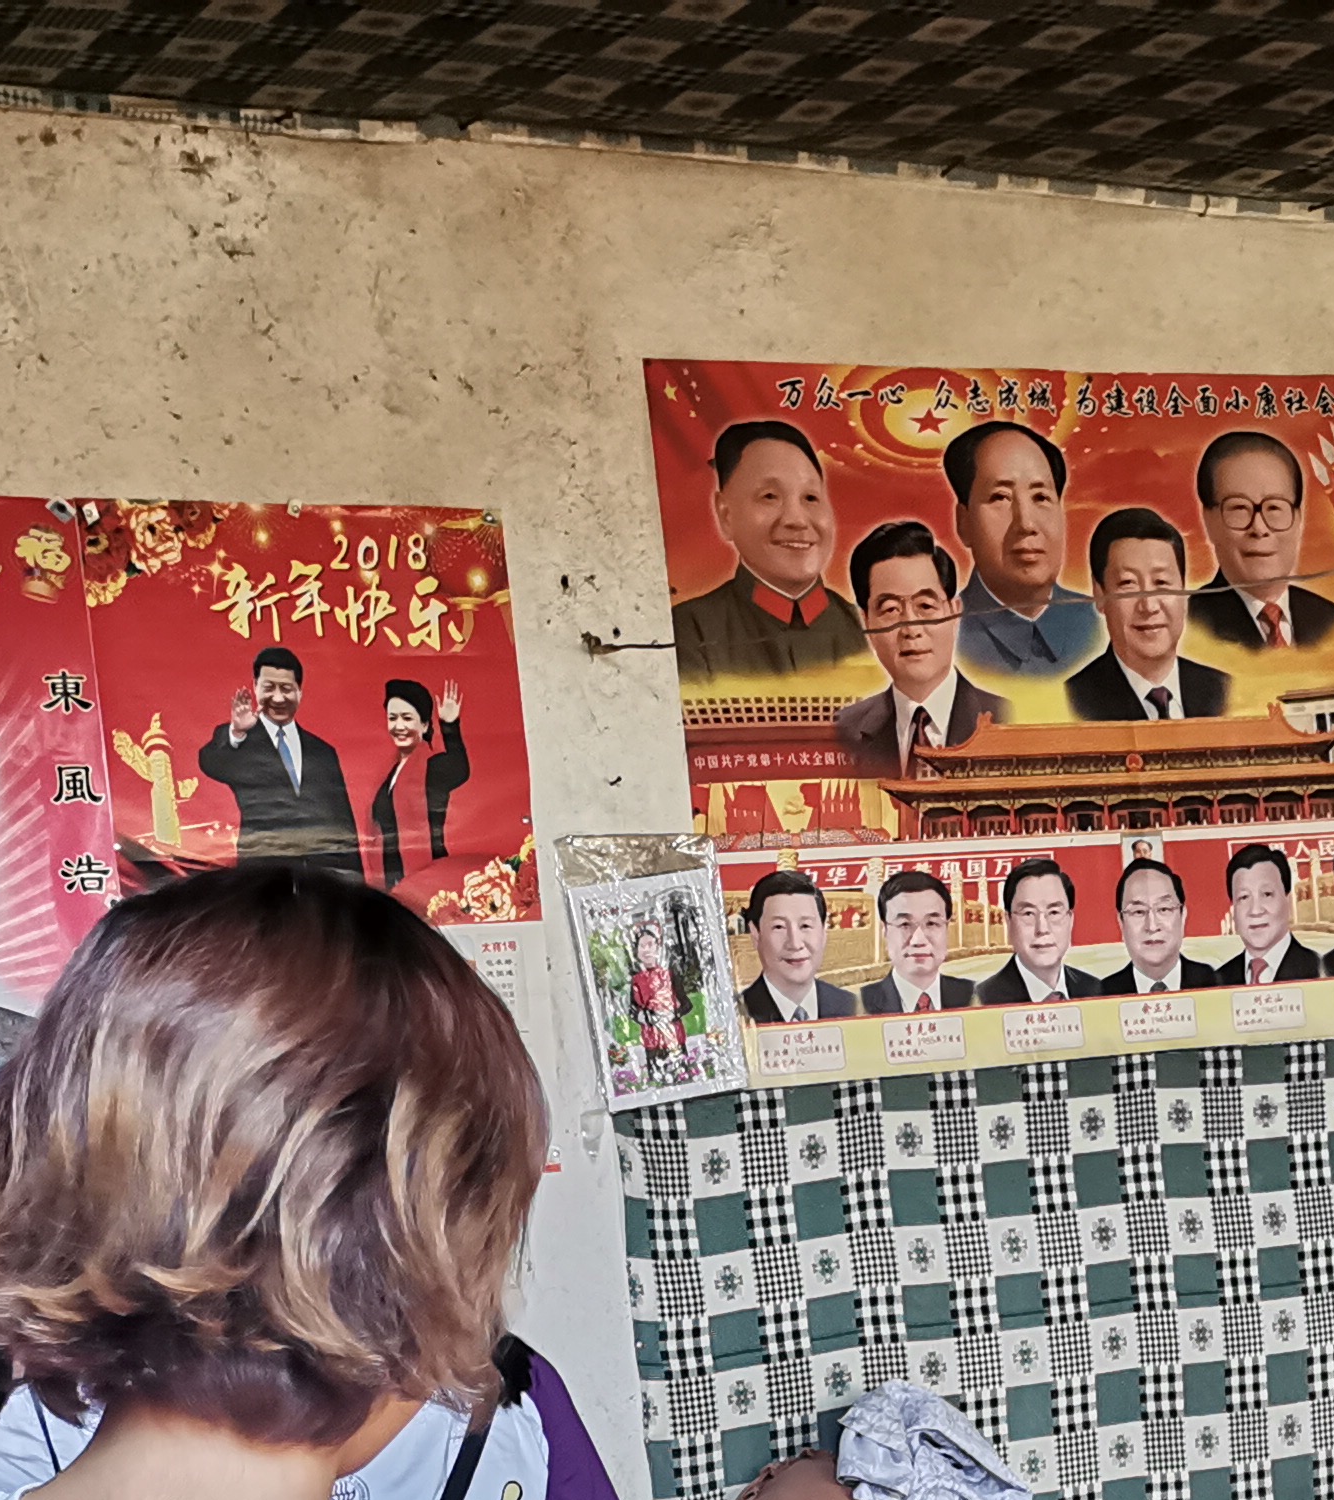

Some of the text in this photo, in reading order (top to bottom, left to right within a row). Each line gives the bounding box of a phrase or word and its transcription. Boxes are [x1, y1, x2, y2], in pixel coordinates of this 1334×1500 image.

[776, 376, 906, 411] 万众一心
[932, 378, 1058, 415] 众志成城
[14, 528, 71, 571] 福
[330, 535, 427, 570] 2018
[209, 560, 465, 652] 新年快乐
